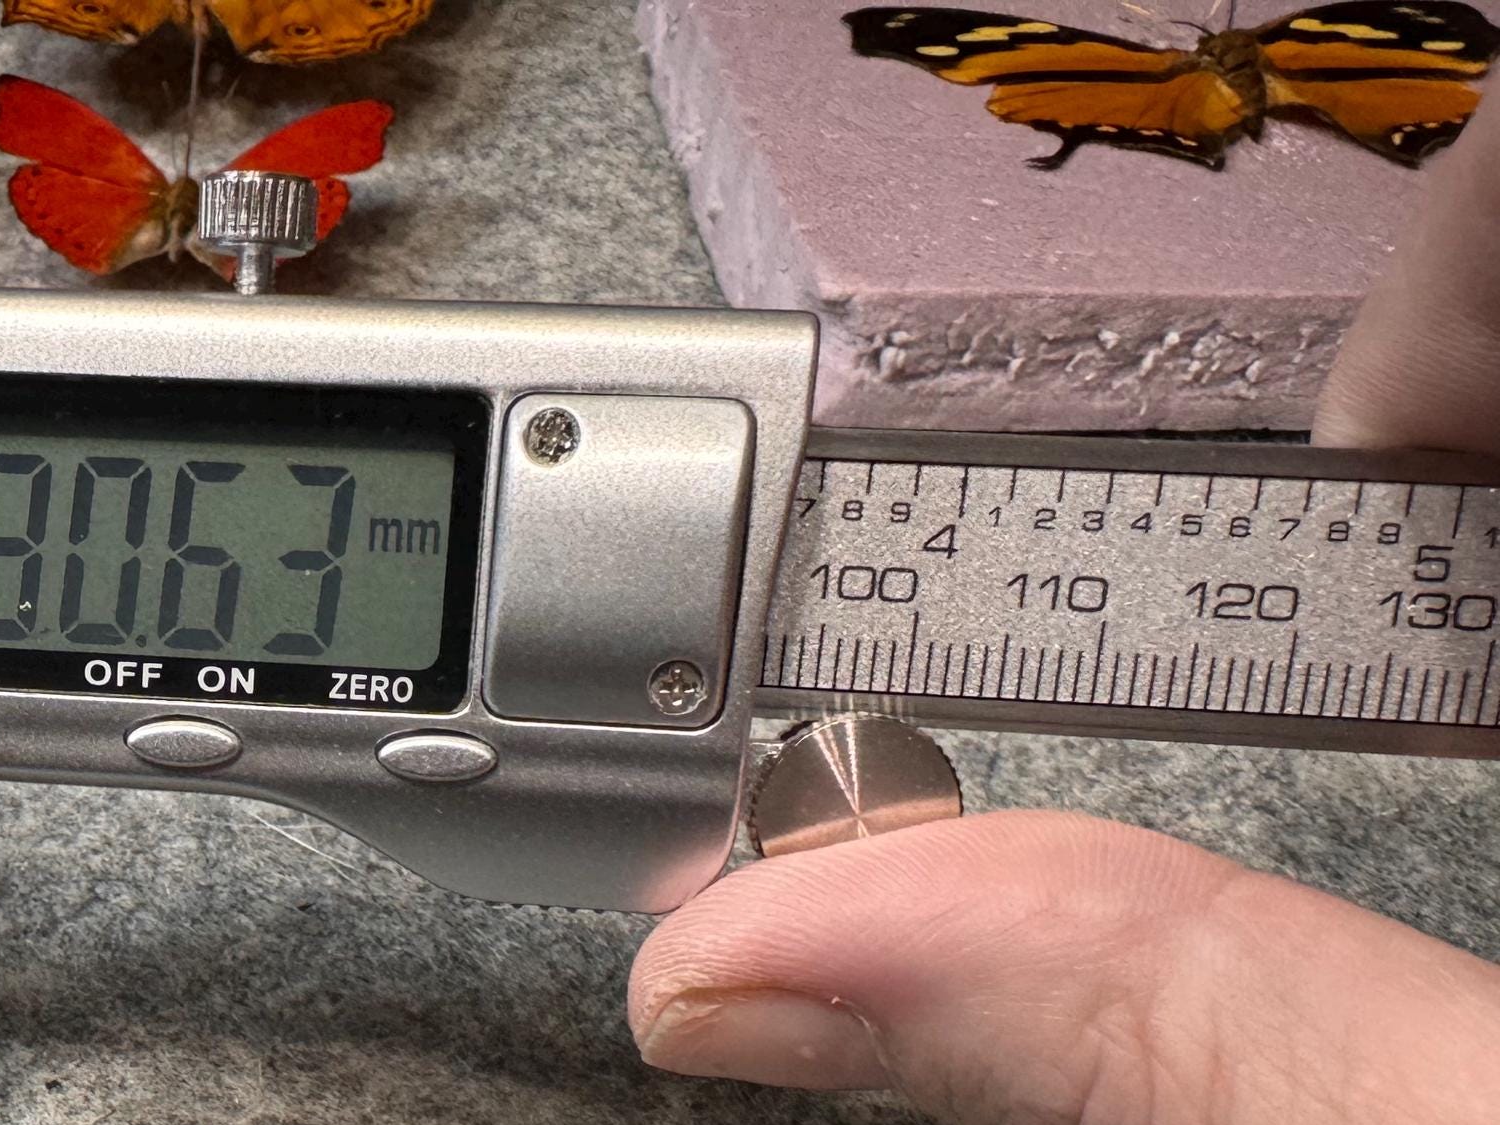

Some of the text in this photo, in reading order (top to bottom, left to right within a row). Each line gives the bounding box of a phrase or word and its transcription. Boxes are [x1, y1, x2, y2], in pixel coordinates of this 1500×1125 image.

[368, 515, 442, 555] mm
[841, 500, 864, 521] 8
[890, 502, 912, 523] 9
[988, 506, 1001, 528] 1
[1033, 508, 1057, 530] 2
[1081, 510, 1105, 532] 3
[1131, 512, 1151, 533] 4
[1180, 514, 1206, 536] 5
[1229, 517, 1250, 538] 6
[1278, 518, 1301, 541] 7
[1327, 521, 1351, 542] 8
[1377, 522, 1401, 544] 9
[923, 523, 1454, 583] 4 5
[810, 564, 1496, 631] 100 110 120 130
[83, 659, 164, 690] OFF
[197, 665, 257, 695] ON
[328, 672, 414, 704] ZERO
